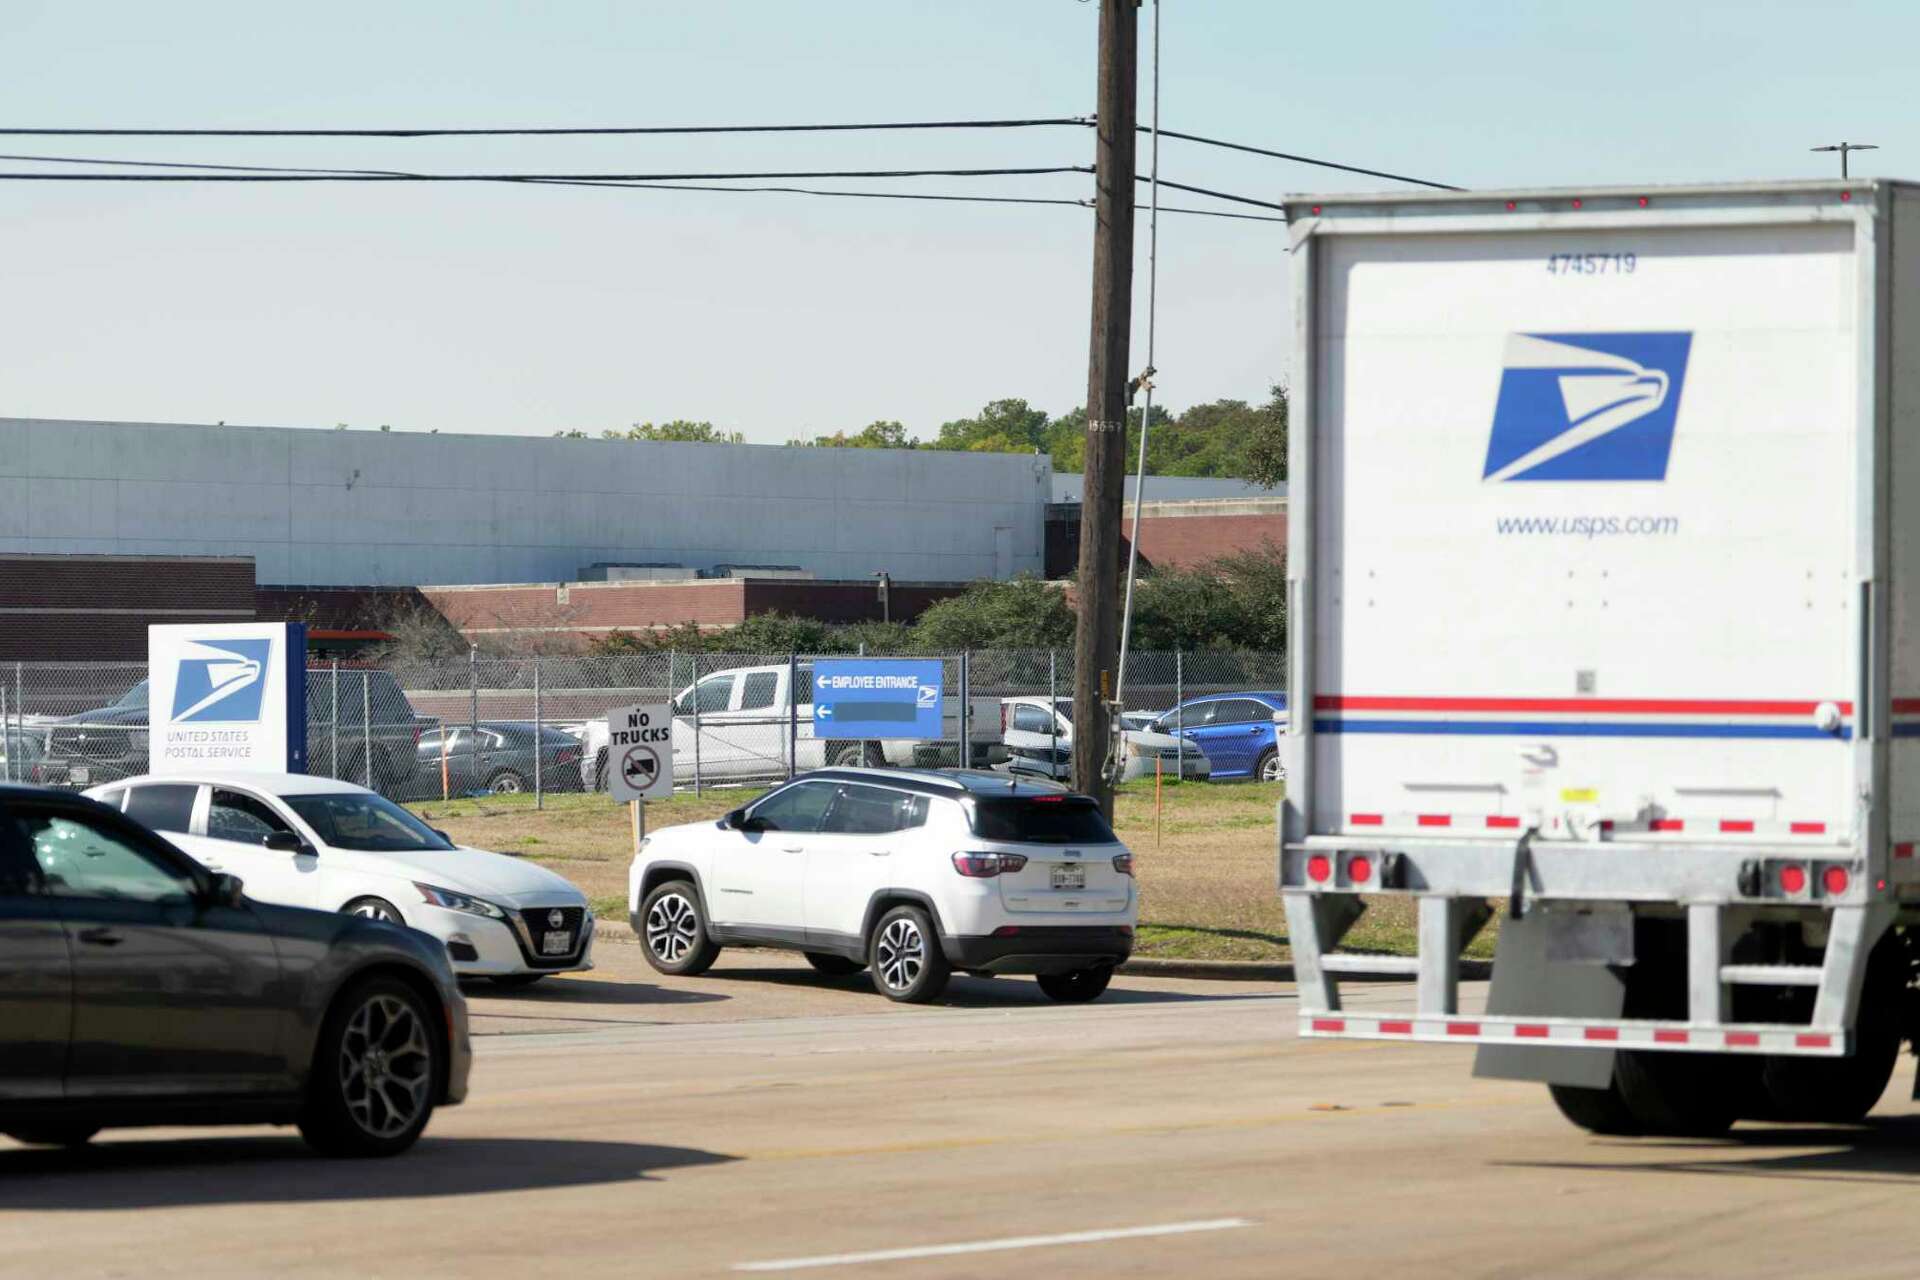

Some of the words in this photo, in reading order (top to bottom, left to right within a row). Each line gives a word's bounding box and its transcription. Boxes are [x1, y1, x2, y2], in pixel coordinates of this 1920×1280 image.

[1546, 252, 1637, 275] 4745719
[1496, 515, 1680, 540] www.usps.com
[832, 675, 875, 689] EMPLOYEE
[875, 675, 918, 689] ENTRANCE
[628, 713, 650, 728] NO
[167, 730, 209, 742] UNITED
[210, 730, 249, 742] STATES
[611, 727, 669, 745] TRUCKS
[165, 746, 205, 759] POSTAL
[207, 746, 252, 758] SERVICE
